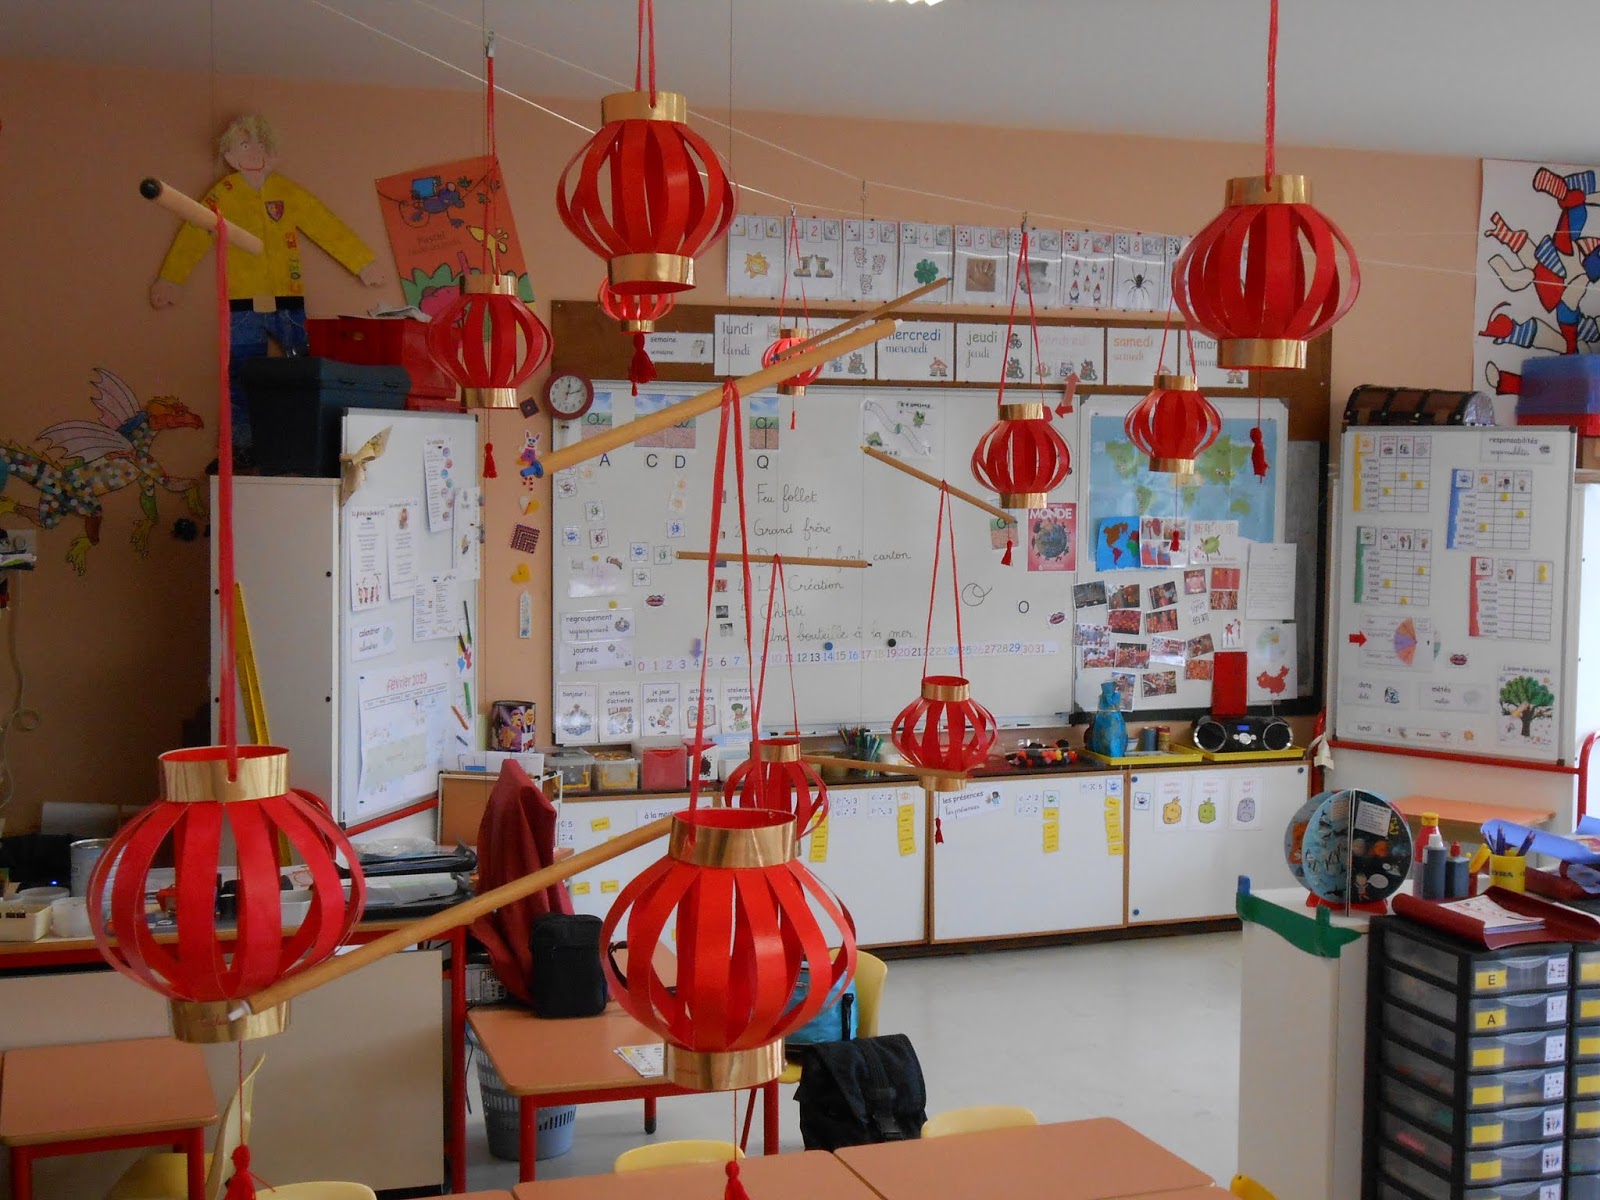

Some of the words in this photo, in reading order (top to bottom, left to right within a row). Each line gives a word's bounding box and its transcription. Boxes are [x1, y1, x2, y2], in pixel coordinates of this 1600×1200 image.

[753, 223, 760, 233] 1
[810, 225, 818, 236] 2
[868, 228, 875, 239] 3
[922, 232, 929, 243] 4
[978, 234, 985, 245] 5
[1030, 236, 1036, 247] 6
[1082, 239, 1089, 249] 7
[1133, 241, 1140, 251] 8
[722, 321, 753, 335] lundi
[967, 331, 998, 347] jeudi
[1113, 336, 1153, 348] samedi
[722, 338, 750, 356] lundi
[886, 344, 928, 354] mercredi
[966, 349, 990, 368] jeudi
[599, 453, 611, 466] A
[646, 454, 658, 468] C
[675, 455, 686, 468] D
[757, 455, 769, 469] Q
[757, 483, 774, 503] Feu
[782, 484, 818, 512] follet
[1029, 508, 1072, 519] MONDE
[754, 519, 793, 536] Grand
[803, 518, 832, 541] frère
[873, 550, 912, 561] carton
[788, 575, 844, 591] Création
[566, 614, 612, 623] regroupement
[359, 627, 380, 638] calendrier
[797, 622, 848, 641] bouteille
[572, 646, 599, 655] journée
[638, 661, 645, 671] 0
[666, 660, 673, 669] 2
[680, 660, 686, 669] 3
[693, 659, 700, 668] 4
[720, 657, 726, 666] 6
[797, 653, 807, 662] 12
[810, 653, 820, 662] 13
[823, 652, 833, 661] 14
[836, 651, 846, 660] 15
[849, 651, 859, 660] 16
[861, 650, 871, 659] 17
[887, 648, 897, 658] 19
[911, 648, 921, 656] 21
[984, 645, 996, 653] 27
[997, 644, 1008, 653] 28
[1009, 643, 1020, 652] 29
[1022, 644, 1034, 653] 30
[1035, 644, 1045, 653] 31
[412, 672, 427, 686] 2019
[953, 791, 984, 803] présences
[1488, 974, 1496, 985] E
[1487, 1014, 1496, 1025] A
